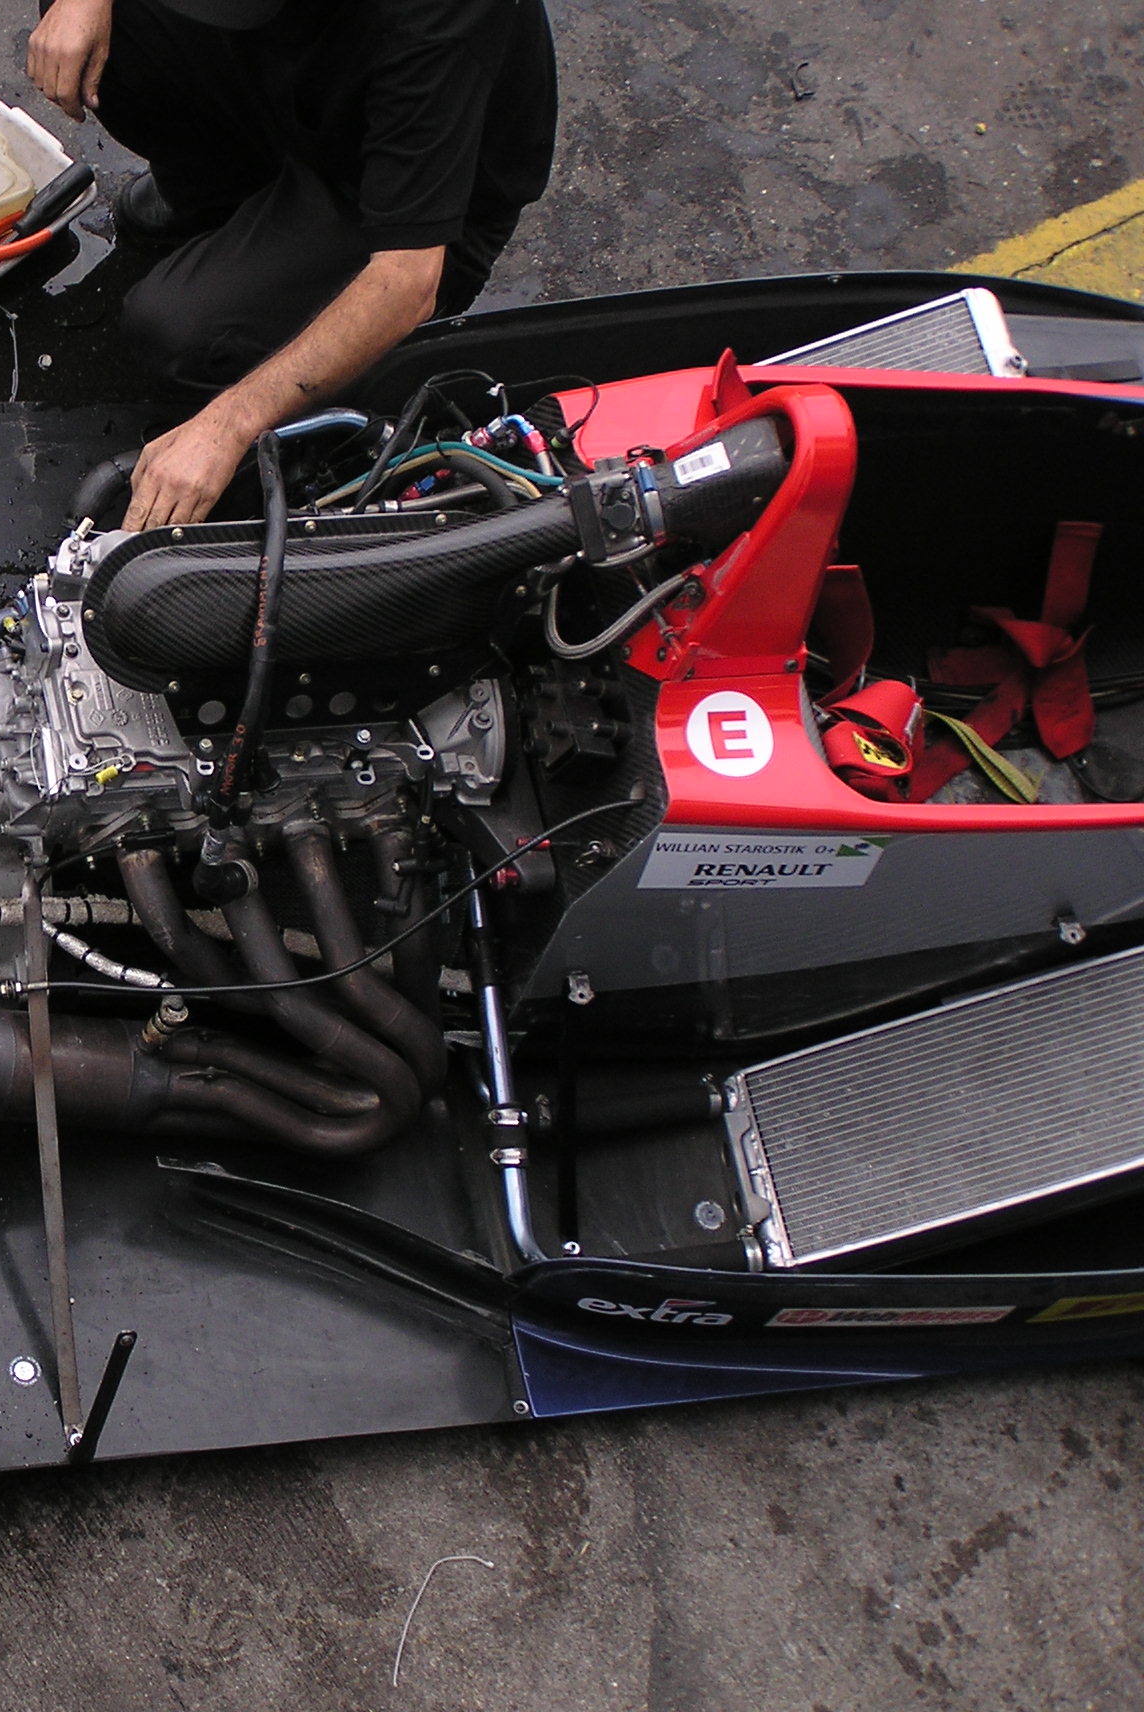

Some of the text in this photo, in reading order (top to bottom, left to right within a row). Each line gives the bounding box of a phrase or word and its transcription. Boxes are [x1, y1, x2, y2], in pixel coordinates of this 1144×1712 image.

[708, 711, 754, 760] E
[656, 843, 720, 853] WILLIAN
[723, 844, 805, 854] STAROSTIK
[694, 863, 833, 876] RENAULT
[577, 1297, 733, 1325] extra
